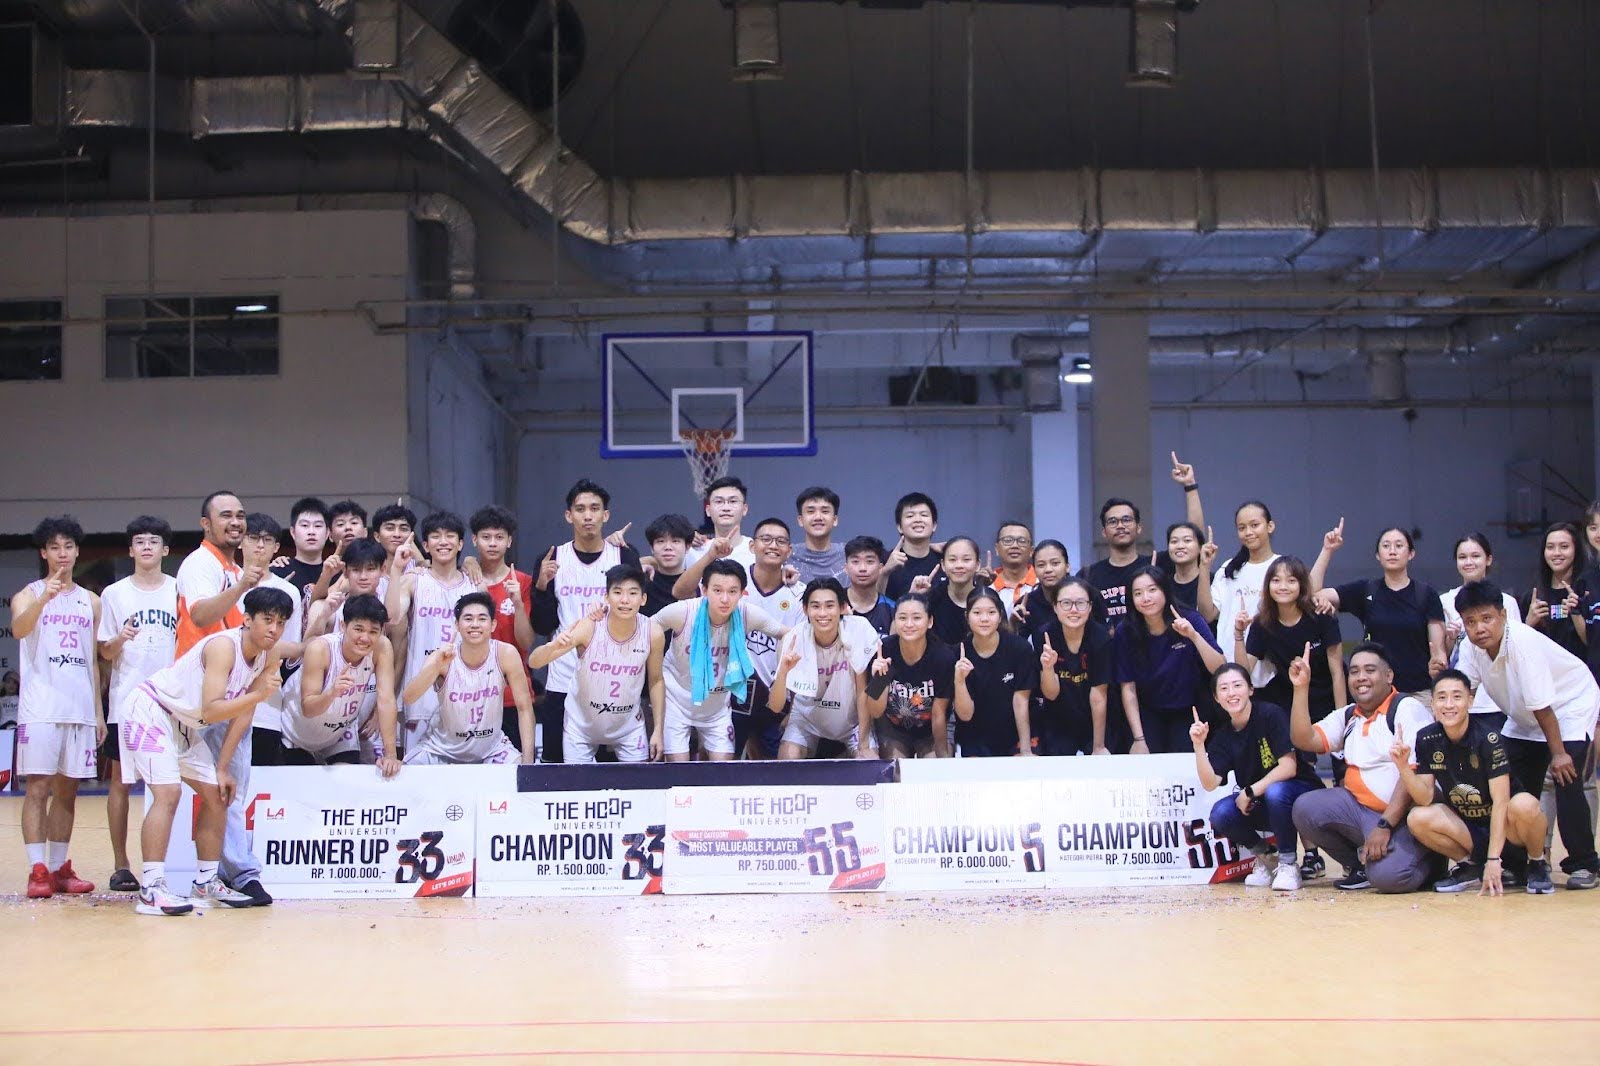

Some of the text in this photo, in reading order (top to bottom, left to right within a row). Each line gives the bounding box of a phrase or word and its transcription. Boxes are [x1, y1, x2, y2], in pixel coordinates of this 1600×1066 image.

[560, 585, 607, 597] CIPUTR
[418, 606, 455, 619] CIPU
[43, 614, 91, 628] CIPUTRA
[441, 624, 451, 642] 5
[59, 631, 78, 649] 25
[610, 681, 620, 697] 2
[342, 700, 358, 717] 16
[590, 701, 633, 714] NEXTGEN
[470, 705, 484, 724] 15
[489, 800, 507, 811] LA
[674, 796, 692, 806] LA
[730, 793, 817, 815] THE HOOP
[267, 807, 285, 817] LA
[321, 805, 407, 826] THE HOOP
[545, 798, 632, 820] THE HOOP
[554, 821, 622, 830] UNIVERSITY
[739, 817, 807, 826] UNIVERSITY
[329, 827, 396, 836] UNIVERSITY
[1058, 820, 1179, 851] CHAMPION
[893, 824, 1015, 854] CHAMPION
[266, 838, 389, 865] RUNNER UP
[490, 833, 613, 861] CHAMPION
[689, 840, 798, 852] MOST VALUEABLE PLAYER
[738, 859, 752, 871] RP.
[940, 857, 955, 869] RP.
[1086, 853, 1103, 861] PUTRA
[1105, 853, 1119, 865] RP.
[311, 868, 325, 879] RP.
[537, 864, 551, 875] RP.
